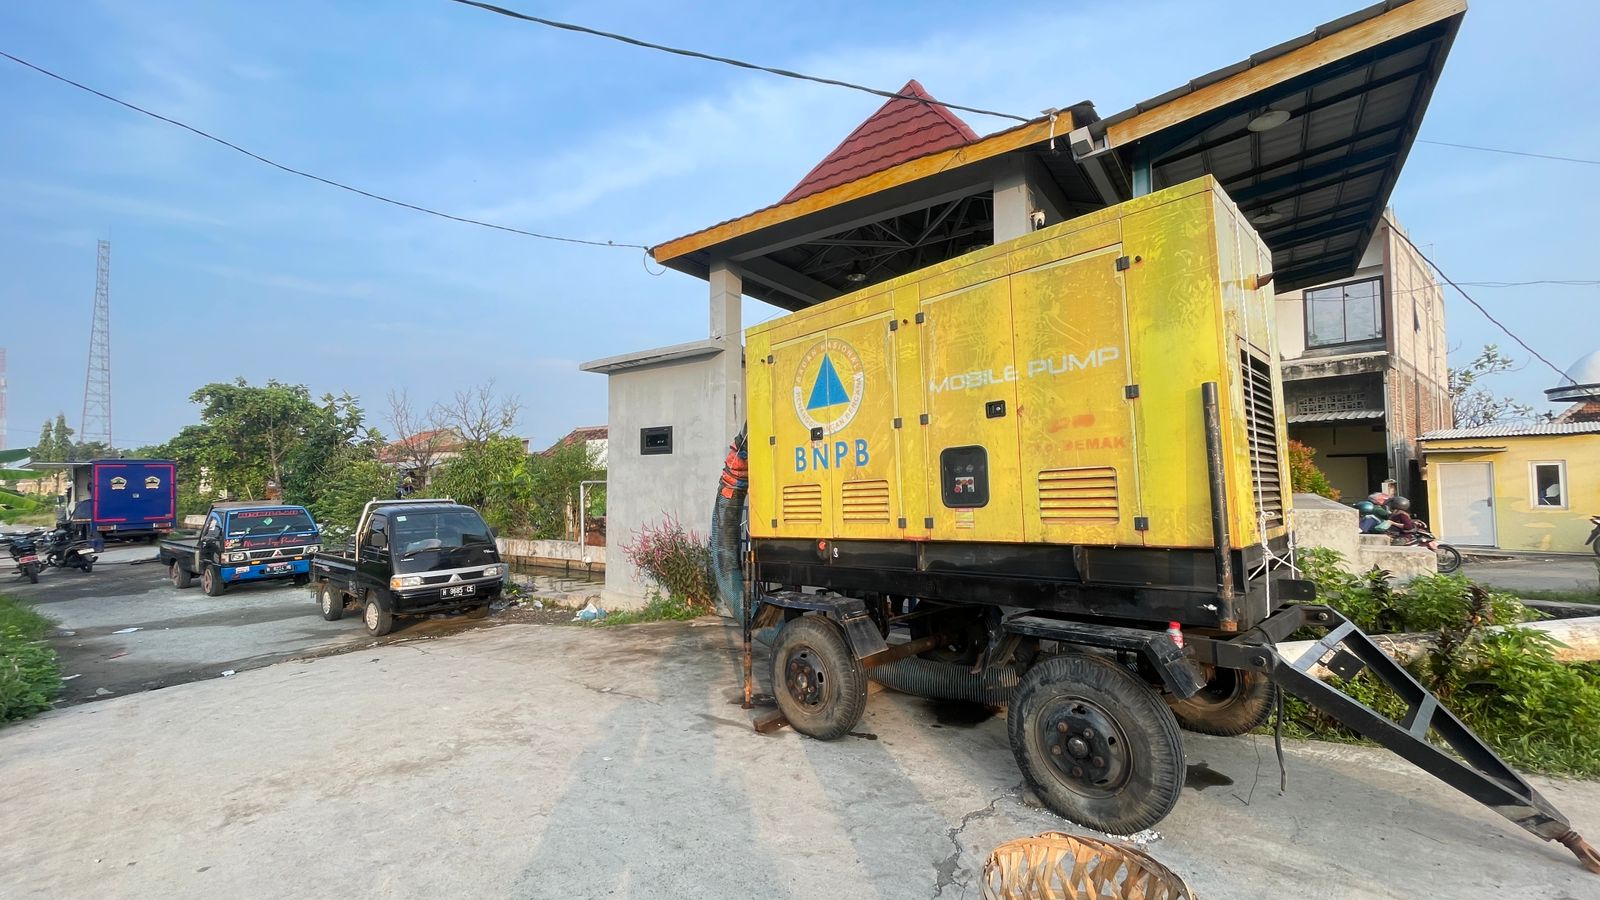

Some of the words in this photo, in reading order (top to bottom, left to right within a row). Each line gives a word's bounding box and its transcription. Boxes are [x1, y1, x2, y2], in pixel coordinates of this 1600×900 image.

[929, 364, 1019, 393] MOBILE
[1027, 347, 1120, 378] PUMP
[795, 438, 870, 472] BNPB
